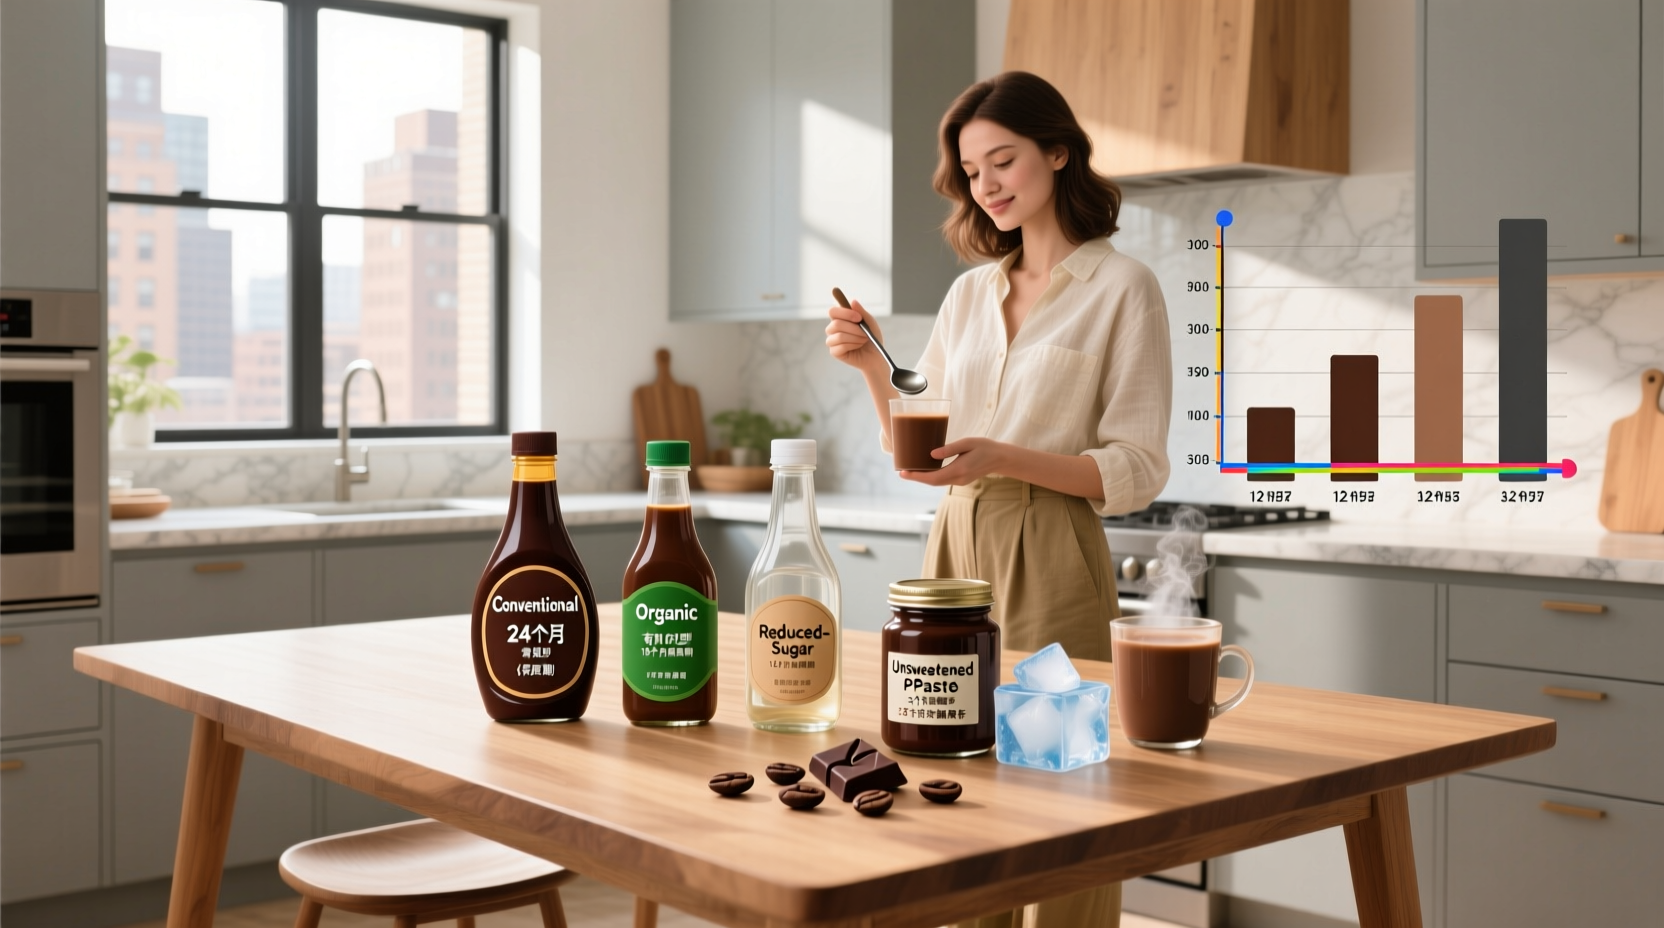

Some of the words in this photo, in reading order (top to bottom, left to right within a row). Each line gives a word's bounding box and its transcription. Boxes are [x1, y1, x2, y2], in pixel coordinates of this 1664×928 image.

[492, 595, 579, 613] Conventional
[635, 602, 699, 626] Organic
[506, 623, 565, 645] 24个月
[759, 623, 831, 640] Reduced-
[771, 640, 815, 659] Sugar
[892, 659, 974, 677] Unsweetened
